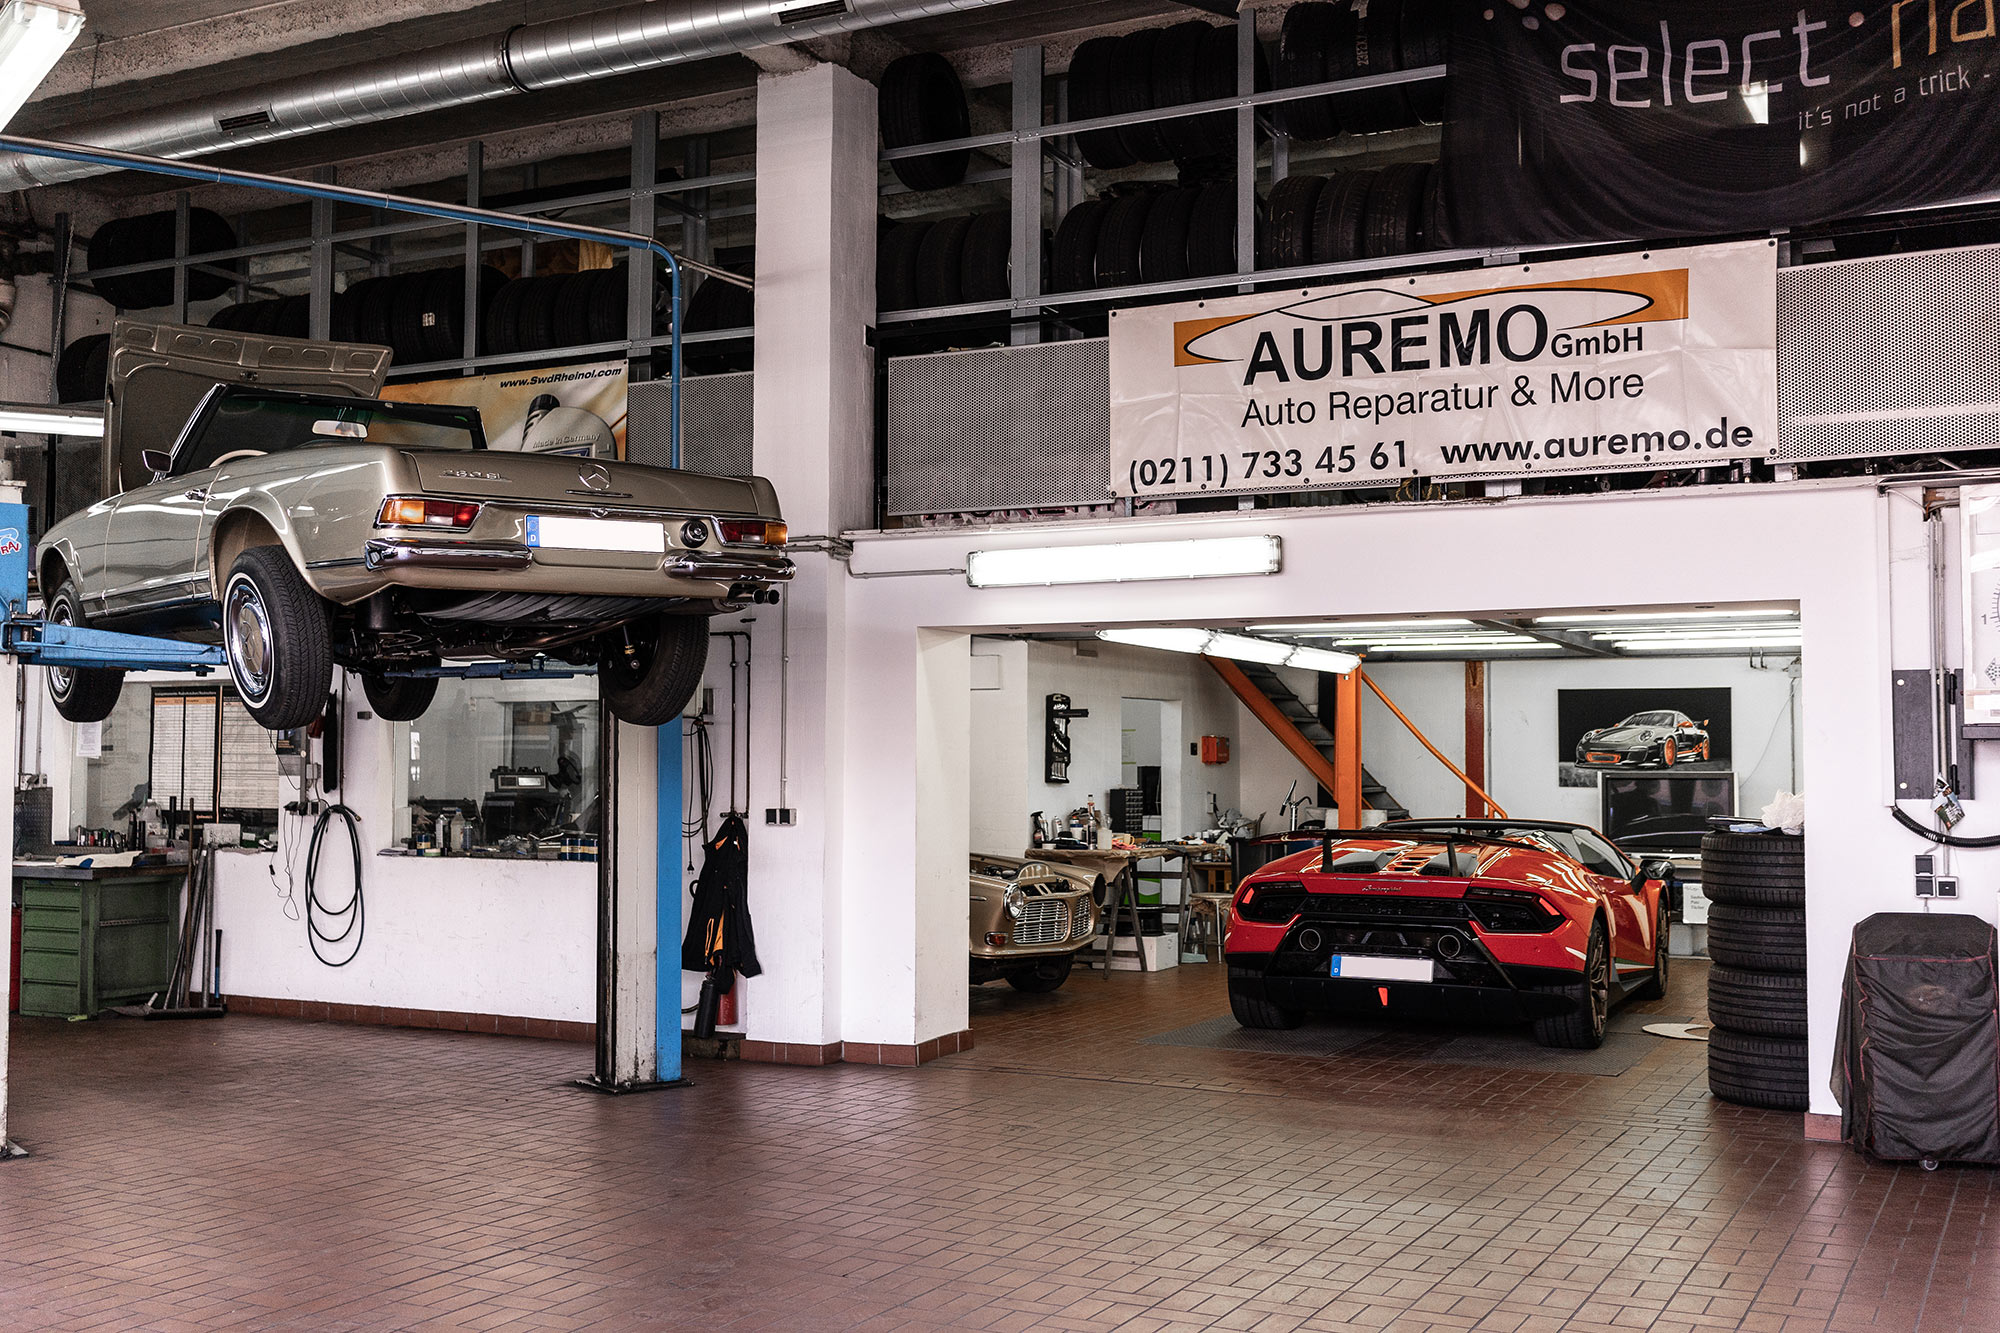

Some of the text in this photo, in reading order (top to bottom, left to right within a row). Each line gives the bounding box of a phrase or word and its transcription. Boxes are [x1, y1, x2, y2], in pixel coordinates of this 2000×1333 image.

[1559, 10, 1831, 108] select
[1799, 106, 1832, 131] it's
[1845, 94, 1881, 120] not
[1894, 87, 1906, 104] a
[1918, 65, 1971, 96] trick
[1242, 305, 1643, 387] AUREMO GmbH
[500, 368, 622, 388] www.SwdRheinol.com
[1241, 371, 1644, 428] Auto Reparatur & More
[1129, 417, 1754, 495] (0211) 733 45 61 www.auremo.de
[530, 534, 537, 542] D
[1981, 614, 1987, 625] 1
